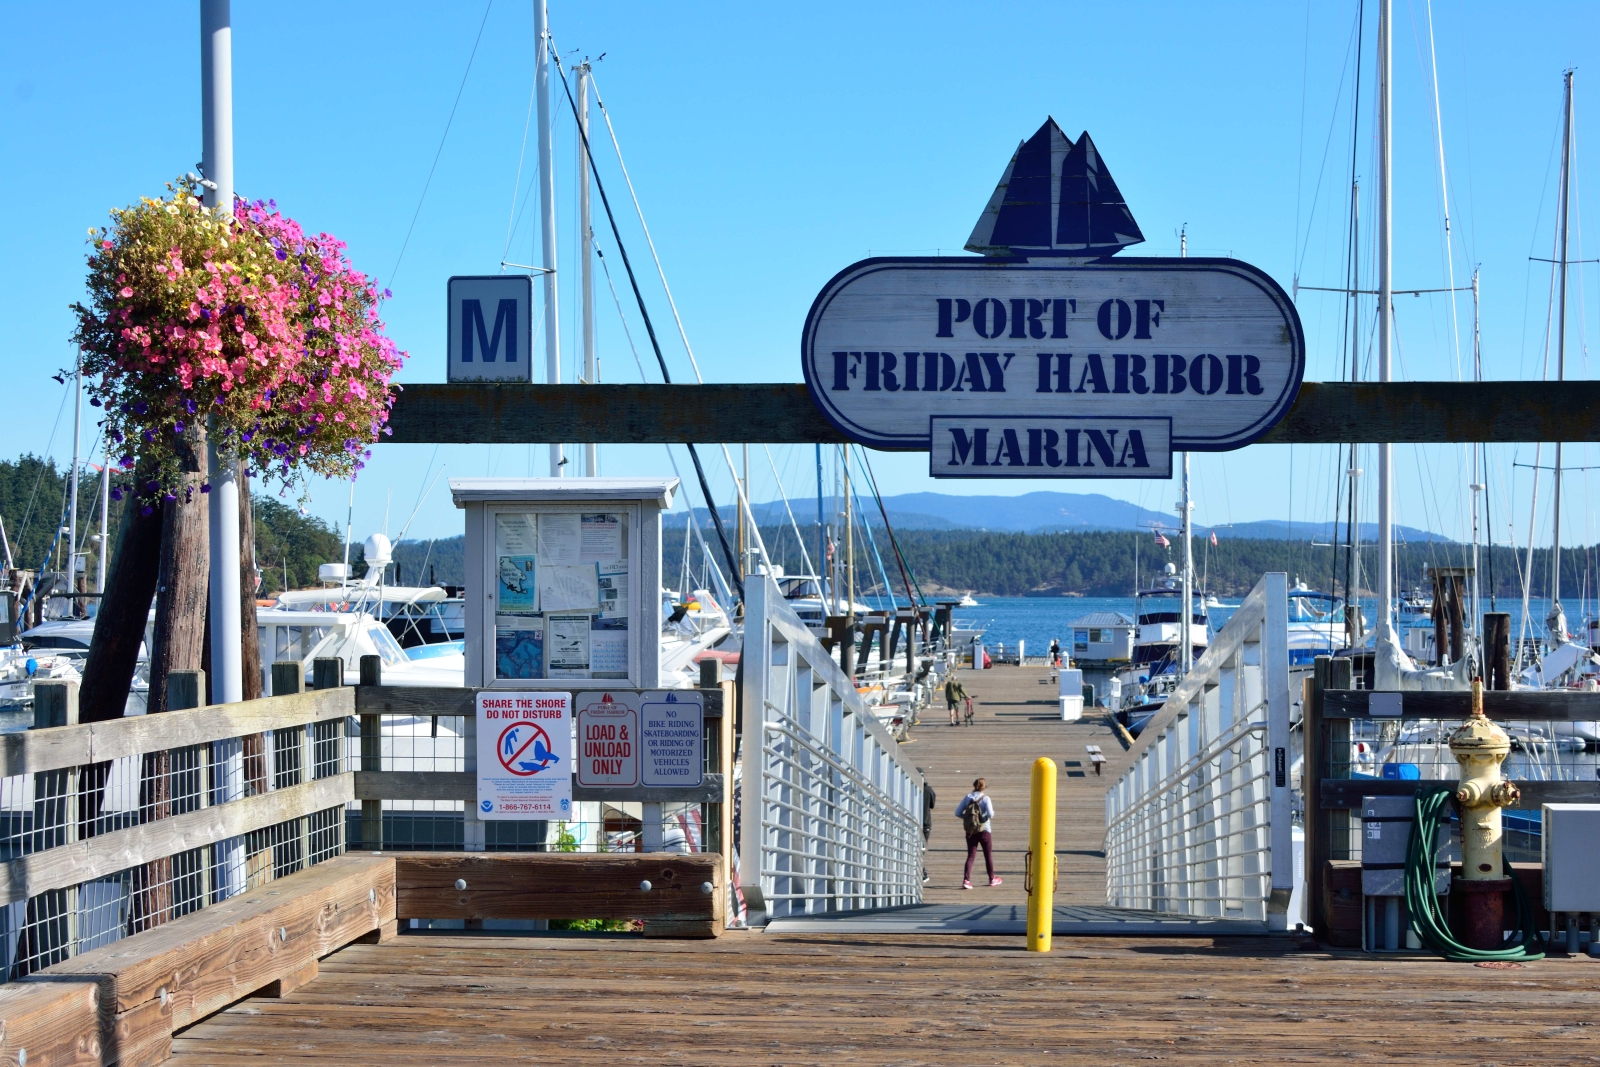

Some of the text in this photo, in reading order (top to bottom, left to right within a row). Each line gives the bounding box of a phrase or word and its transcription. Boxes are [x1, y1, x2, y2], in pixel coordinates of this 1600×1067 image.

[936, 298, 1166, 342] PORT OF
[462, 299, 518, 363] M
[832, 352, 1266, 397] FRIDAY HARBOR
[948, 428, 1151, 469] MARINA
[482, 699, 566, 709] SHARE THE SHORE
[486, 710, 562, 719] DO NOT DISTURB
[648, 720, 695, 728] BIKE RIDING
[586, 725, 629, 741] LOAD &
[644, 730, 699, 738] SKATEBOARDING
[648, 739, 695, 747] OR RIDING OF
[584, 742, 631, 758] UNLOAD
[650, 749, 693, 757] MOTORIZED
[653, 758, 690, 766] VEHICLES
[592, 759, 623, 775] ONLY
[653, 768, 690, 776] ALLOWED
[499, 803, 551, 811] 1-866-767-6114
